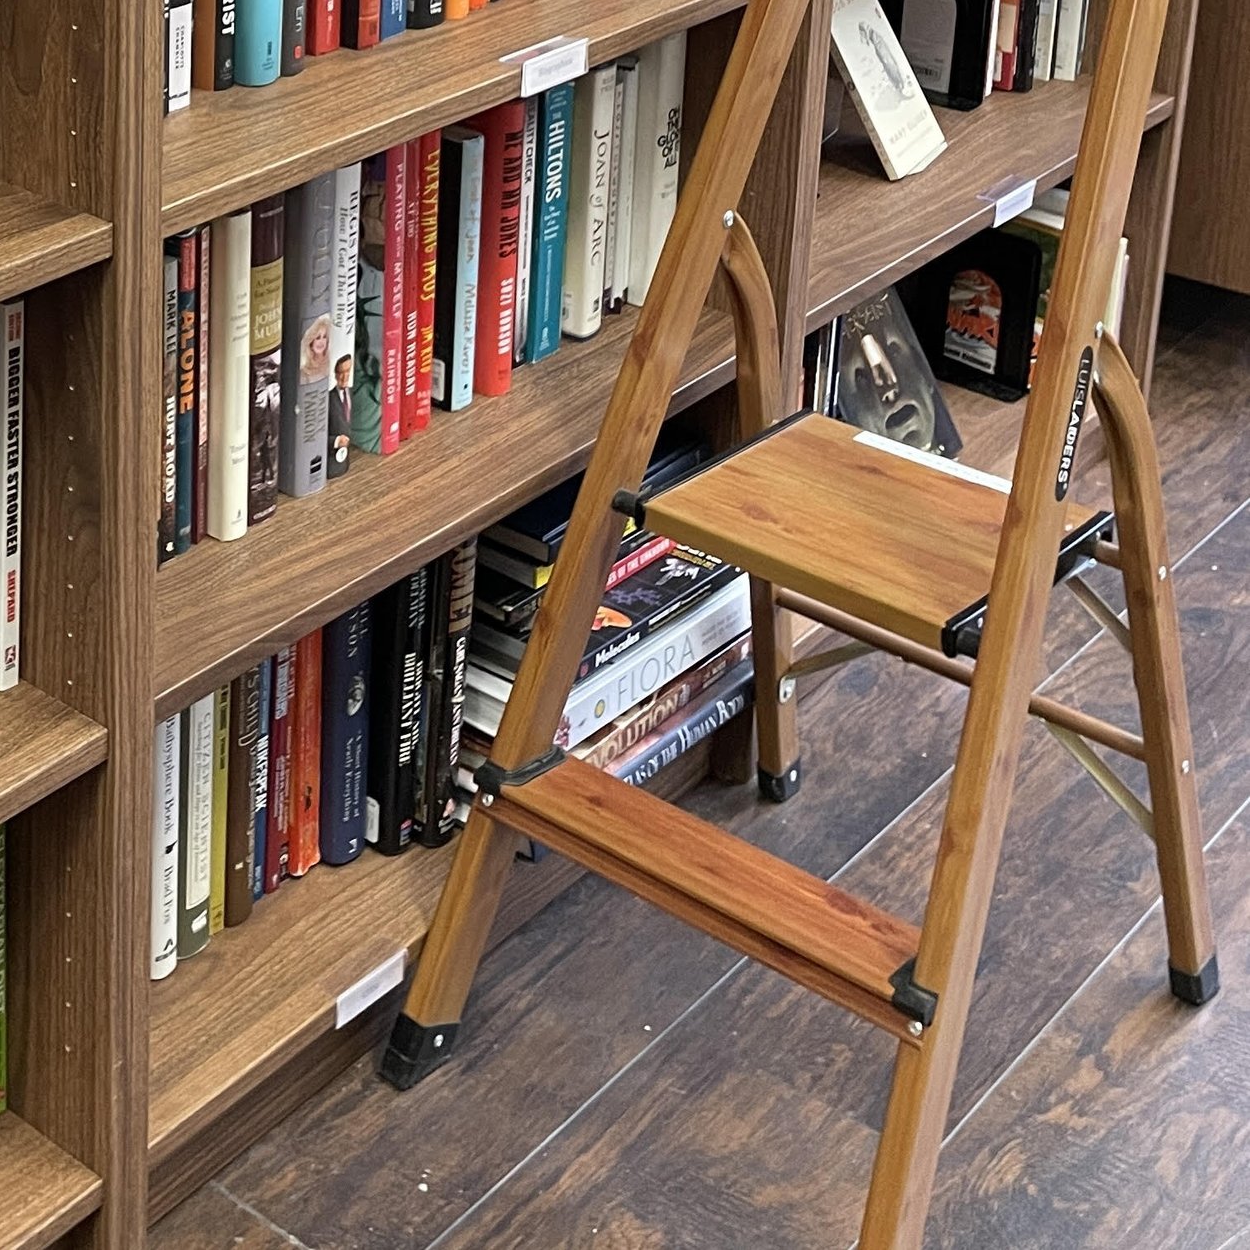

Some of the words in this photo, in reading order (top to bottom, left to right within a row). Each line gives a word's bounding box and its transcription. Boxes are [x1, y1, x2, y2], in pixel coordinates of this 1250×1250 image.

[545, 119, 565, 203] HILTONS
[179, 311, 195, 415] ALONE
[618, 635, 693, 710] FLORA
